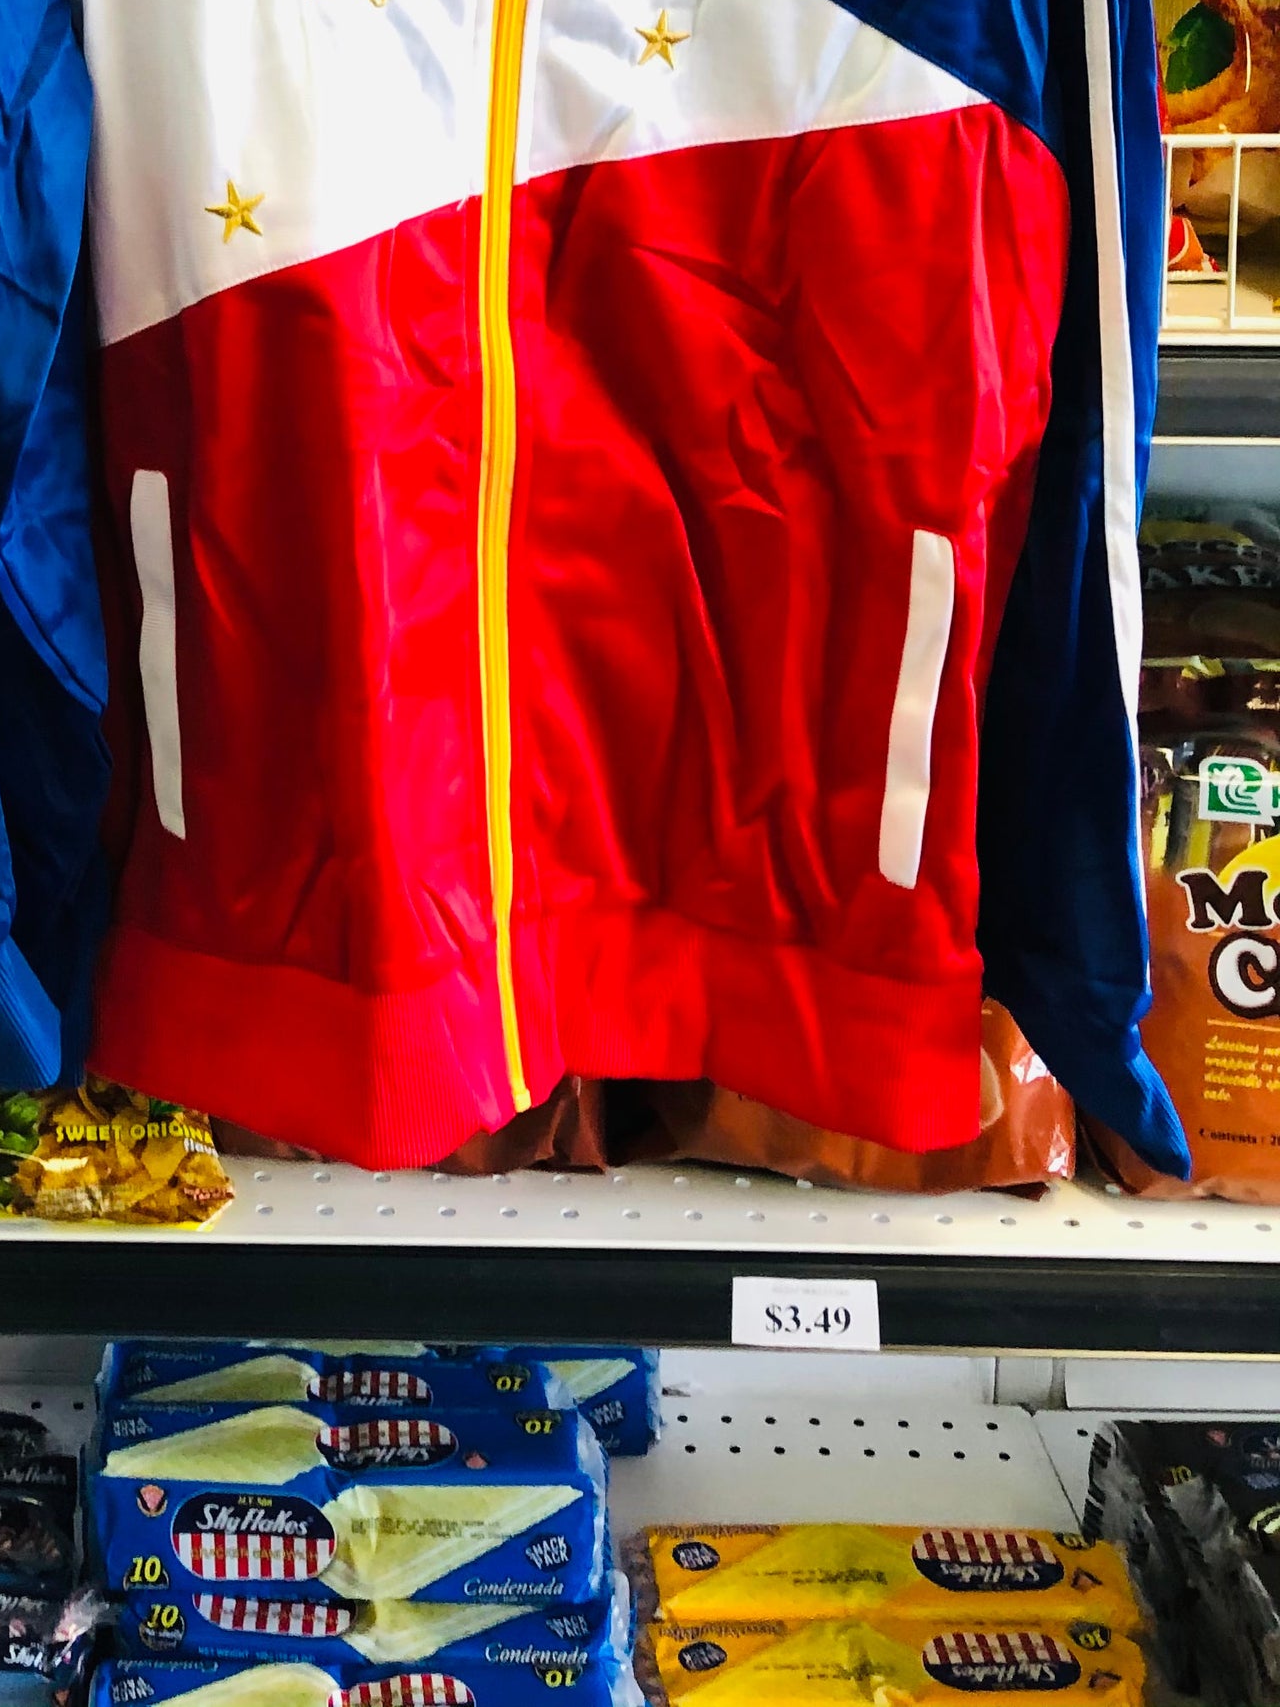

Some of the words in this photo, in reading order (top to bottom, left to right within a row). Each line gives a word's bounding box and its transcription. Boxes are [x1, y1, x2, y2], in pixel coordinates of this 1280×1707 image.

[55, 1124, 122, 1143] SWEET
[765, 1303, 851, 1335] $3.49
[195, 1503, 309, 1536] SkyFlakes
[130, 1555, 162, 1583] 10
[463, 1576, 564, 1597] Condensada
[147, 1603, 179, 1628] 10
[485, 1642, 589, 1665] Condensada
[545, 1670, 576, 1689] 10
